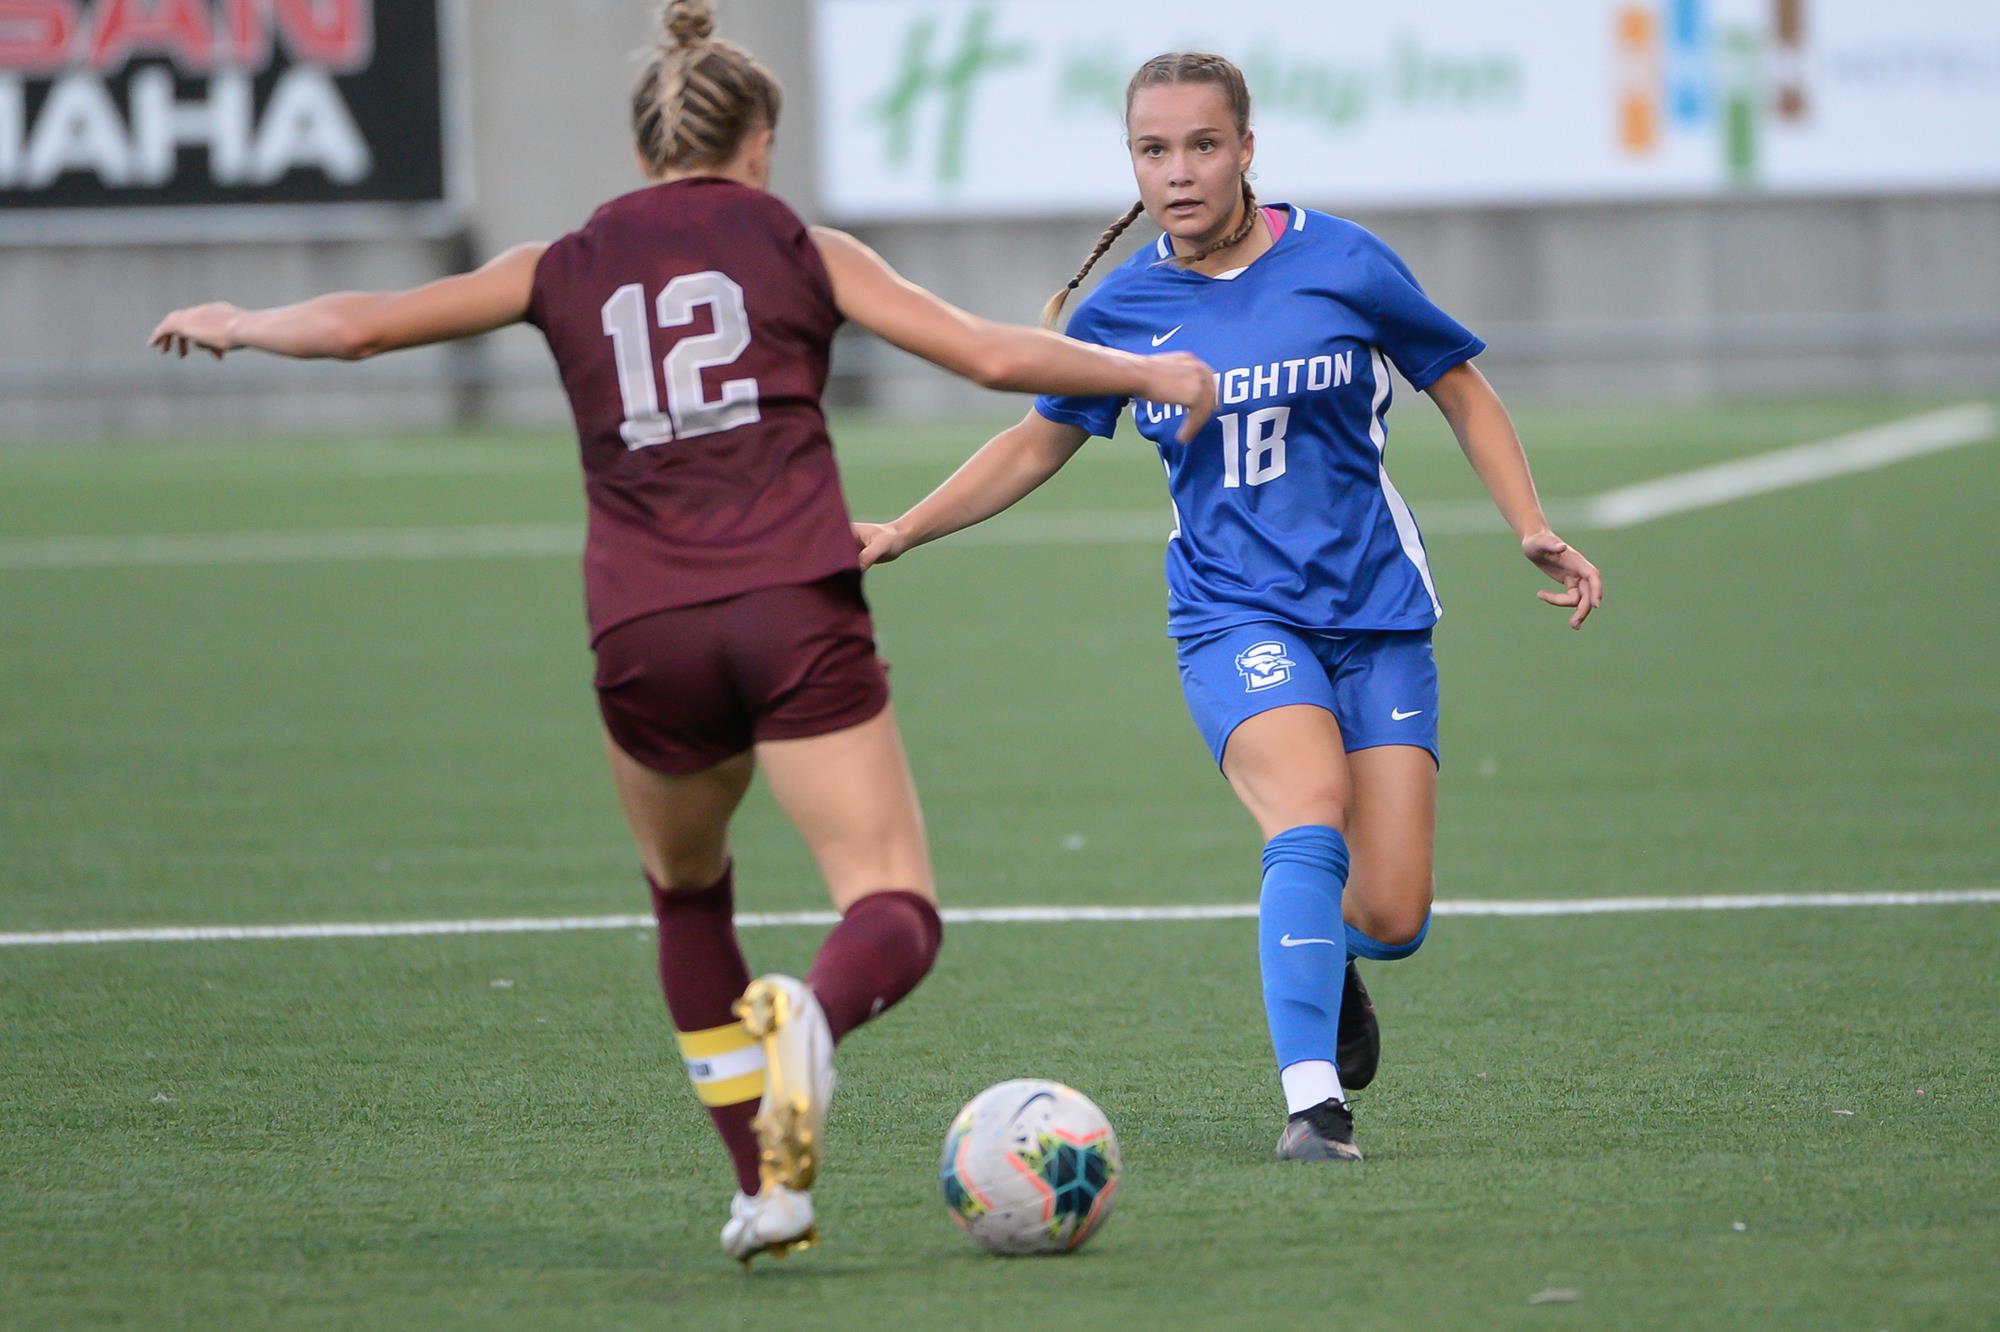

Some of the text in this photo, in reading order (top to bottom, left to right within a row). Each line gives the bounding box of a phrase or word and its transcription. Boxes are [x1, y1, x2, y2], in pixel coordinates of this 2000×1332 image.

[601, 270, 761, 451] 12
[1147, 350, 1352, 424] CIGHTON
[1216, 406, 1291, 489] 18
